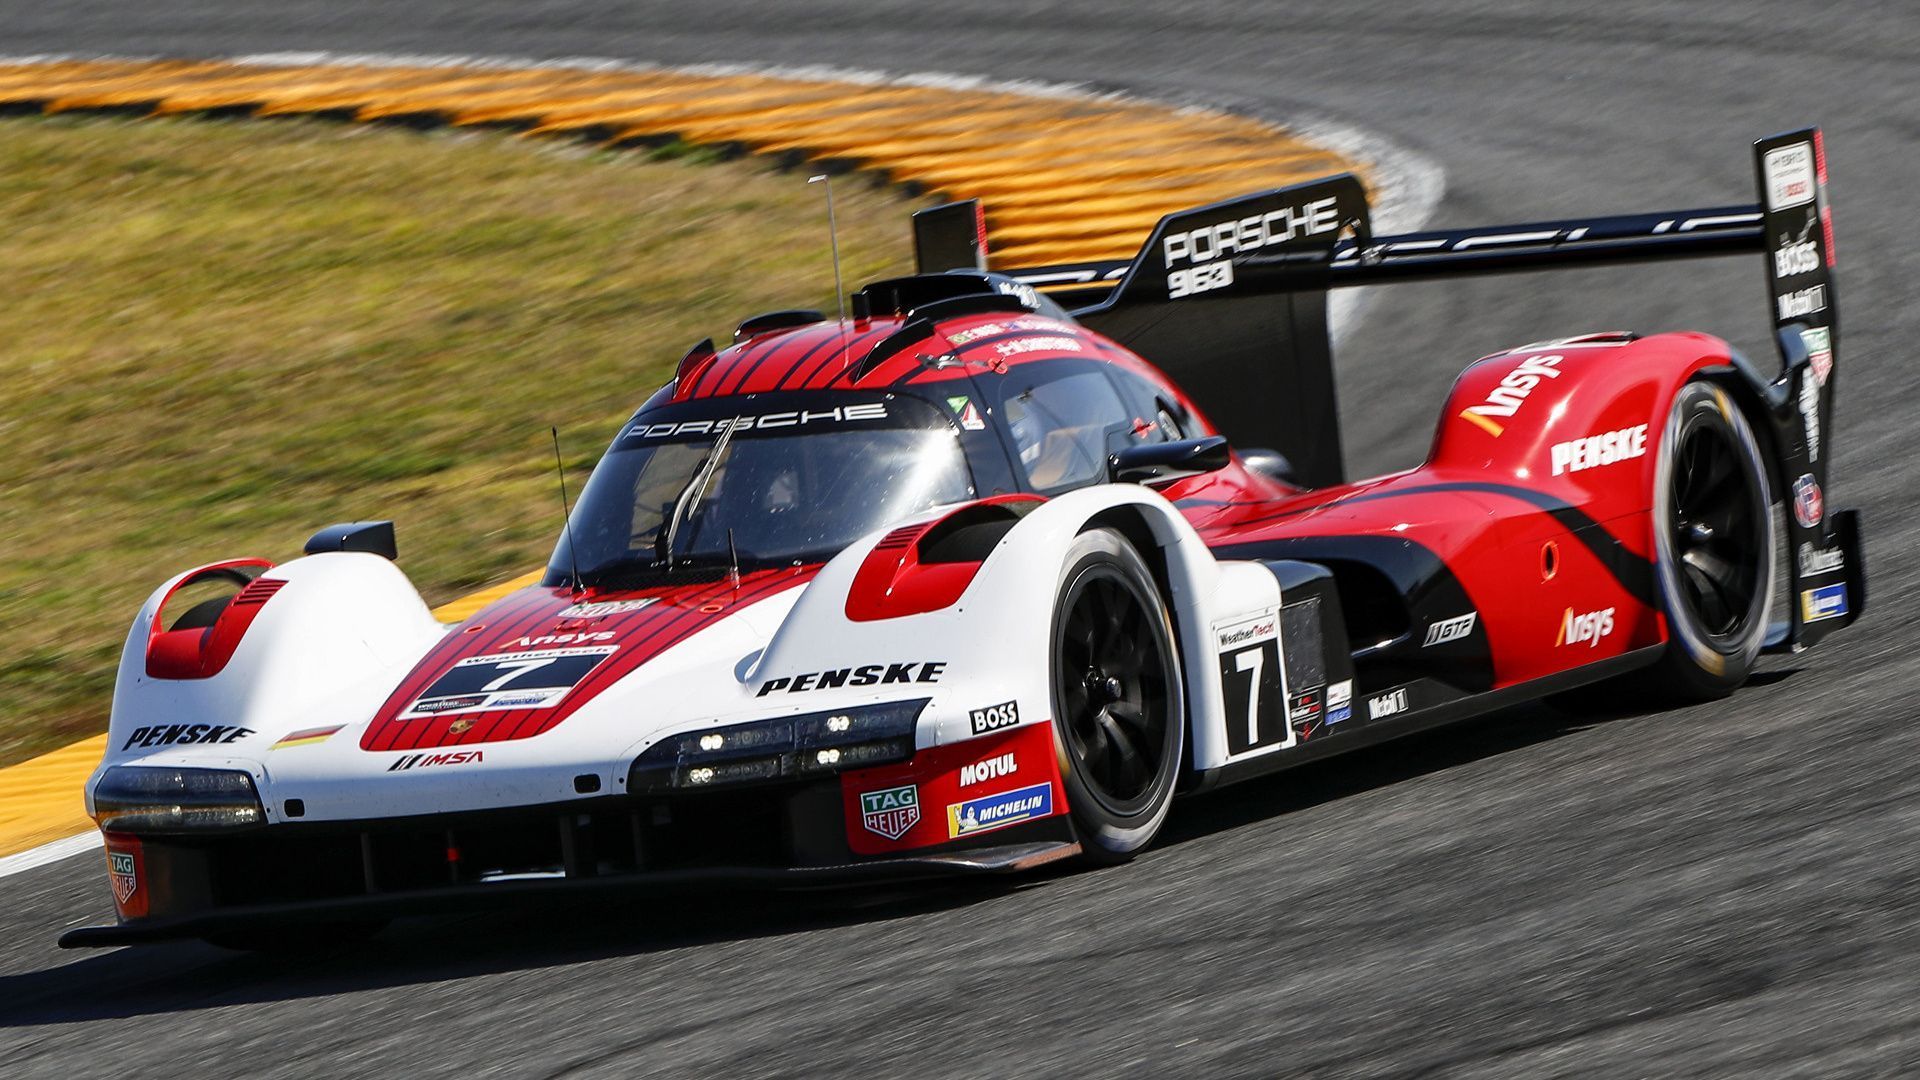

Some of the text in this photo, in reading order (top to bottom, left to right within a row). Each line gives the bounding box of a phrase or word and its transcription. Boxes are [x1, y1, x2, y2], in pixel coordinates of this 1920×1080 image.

[1163, 196, 1339, 269] PORSCHE
[1167, 259, 1235, 299] 963
[1458, 355, 1565, 438] Ansys
[622, 403, 888, 441] PORSCHE
[1551, 423, 1649, 477] PENSKE
[498, 631, 617, 649] Ansys
[1555, 606, 1616, 648] Ansys
[481, 657, 558, 692] 7
[755, 662, 948, 698] PENSKE
[1235, 646, 1265, 745] 7
[974, 703, 1017, 733] BOSS
[122, 724, 258, 751] PENSKE
[418, 751, 484, 768] IMSA
[959, 752, 1018, 788] MOTUL
[866, 789, 914, 811] TAG
[979, 795, 1043, 822] MICHELIN
[867, 810, 917, 836] HEUER
[111, 856, 132, 872] TAG
